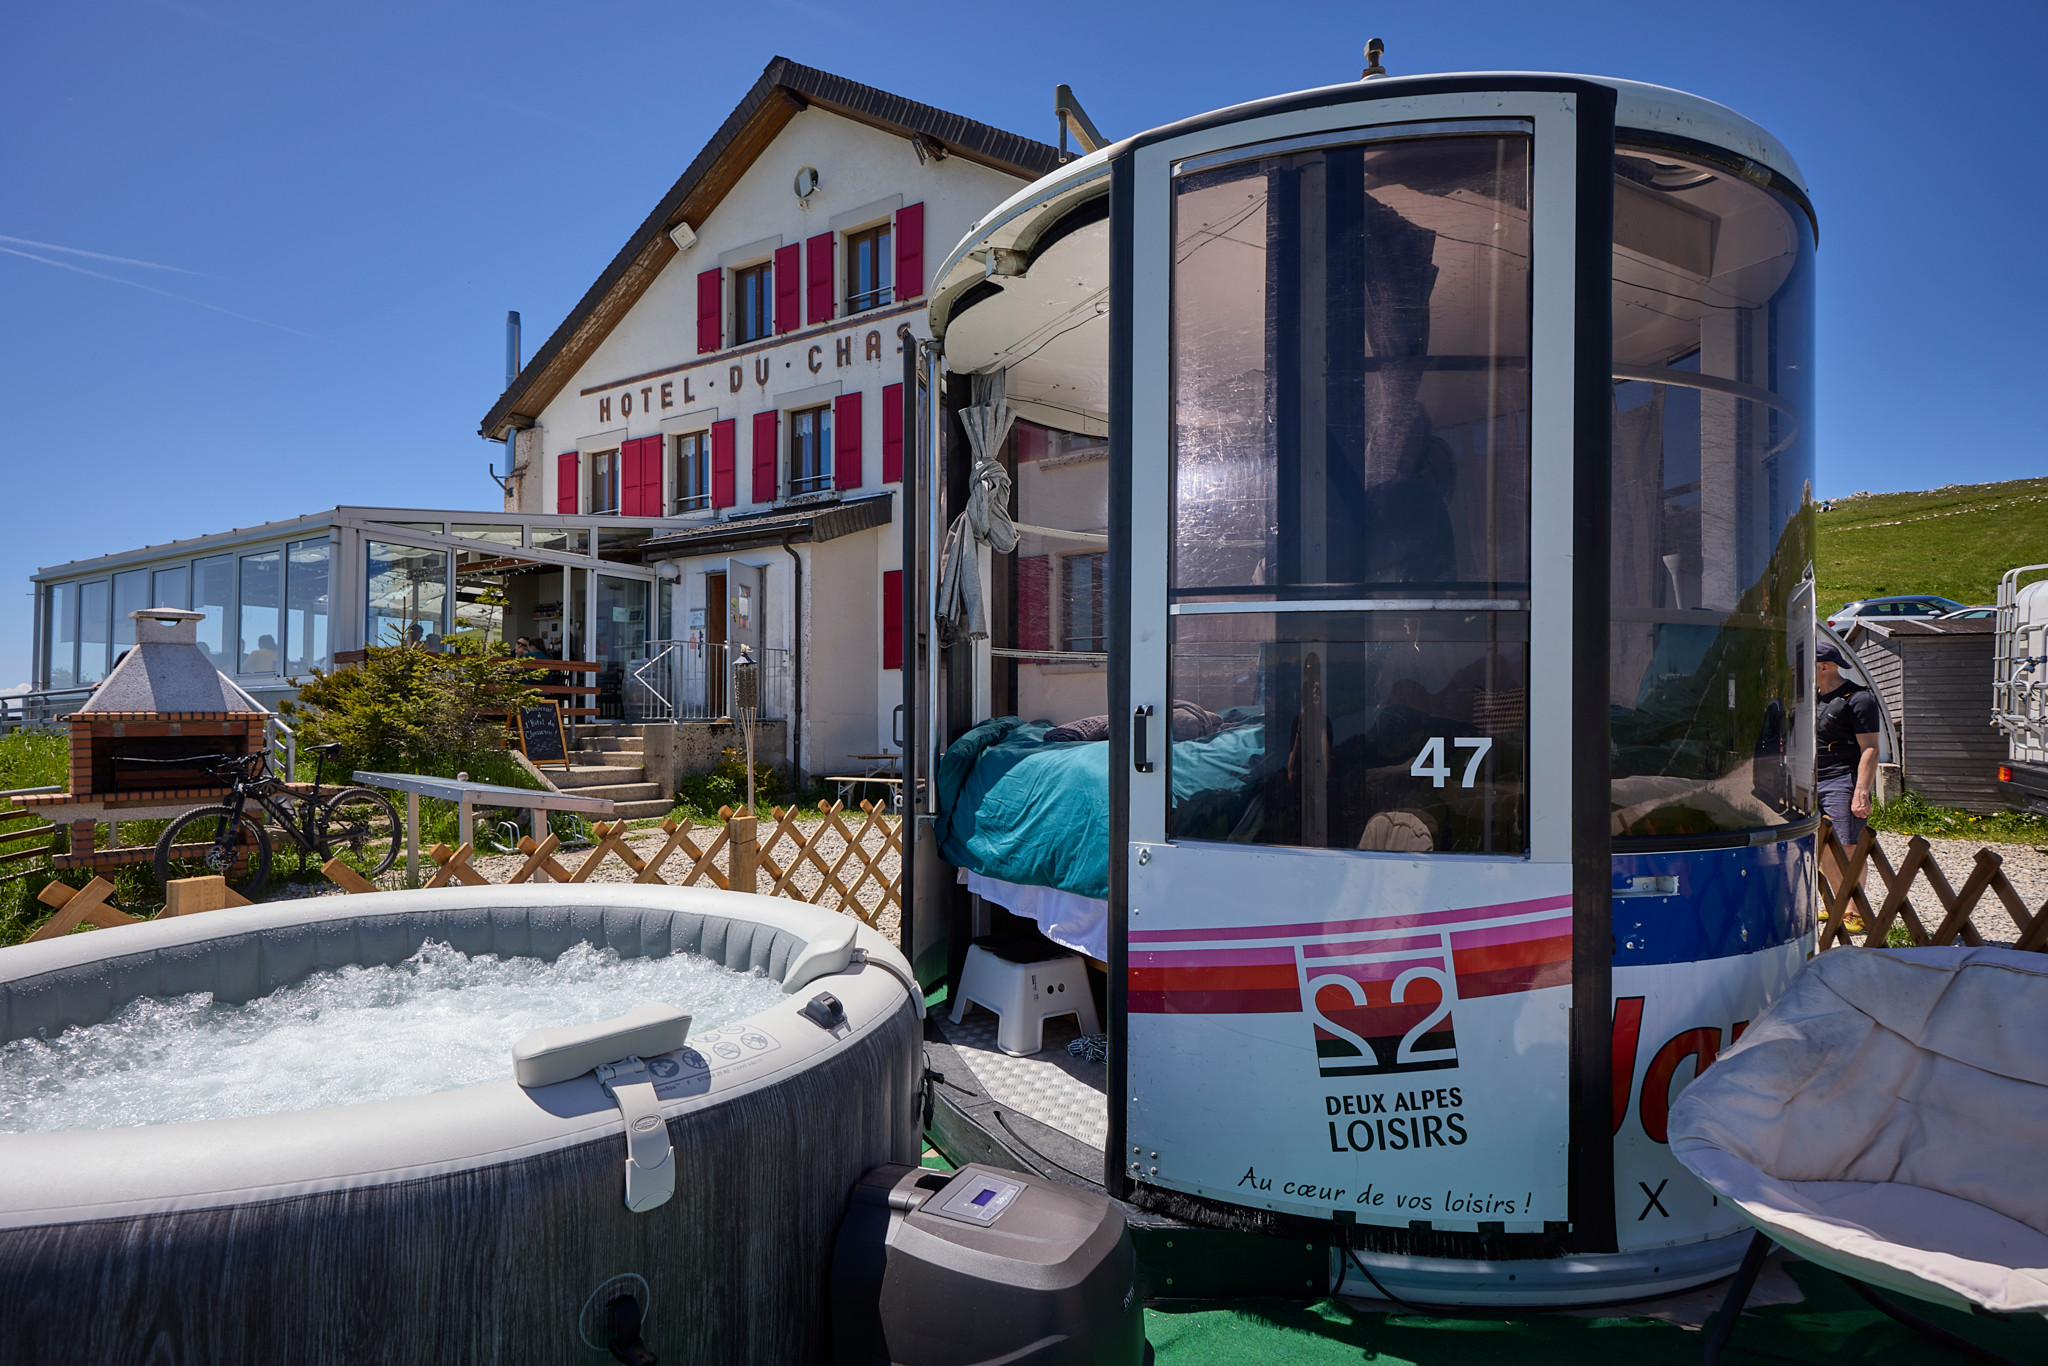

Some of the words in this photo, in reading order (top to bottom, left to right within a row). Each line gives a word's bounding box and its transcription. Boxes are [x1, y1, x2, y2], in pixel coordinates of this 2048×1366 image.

[599, 377, 695, 423] HOTEL
[729, 357, 769, 393] DU
[1410, 737, 1493, 788] 47
[1325, 1093, 1387, 1116] DEUX
[1394, 1087, 1463, 1112] ALPES
[1328, 1112, 1468, 1153] LOISIRS
[1237, 1166, 1272, 1191] Au
[1283, 1181, 1346, 1201] cœur
[1356, 1183, 1385, 1206] de
[1396, 1194, 1433, 1211] vos
[1444, 1190, 1515, 1214] loisirs
